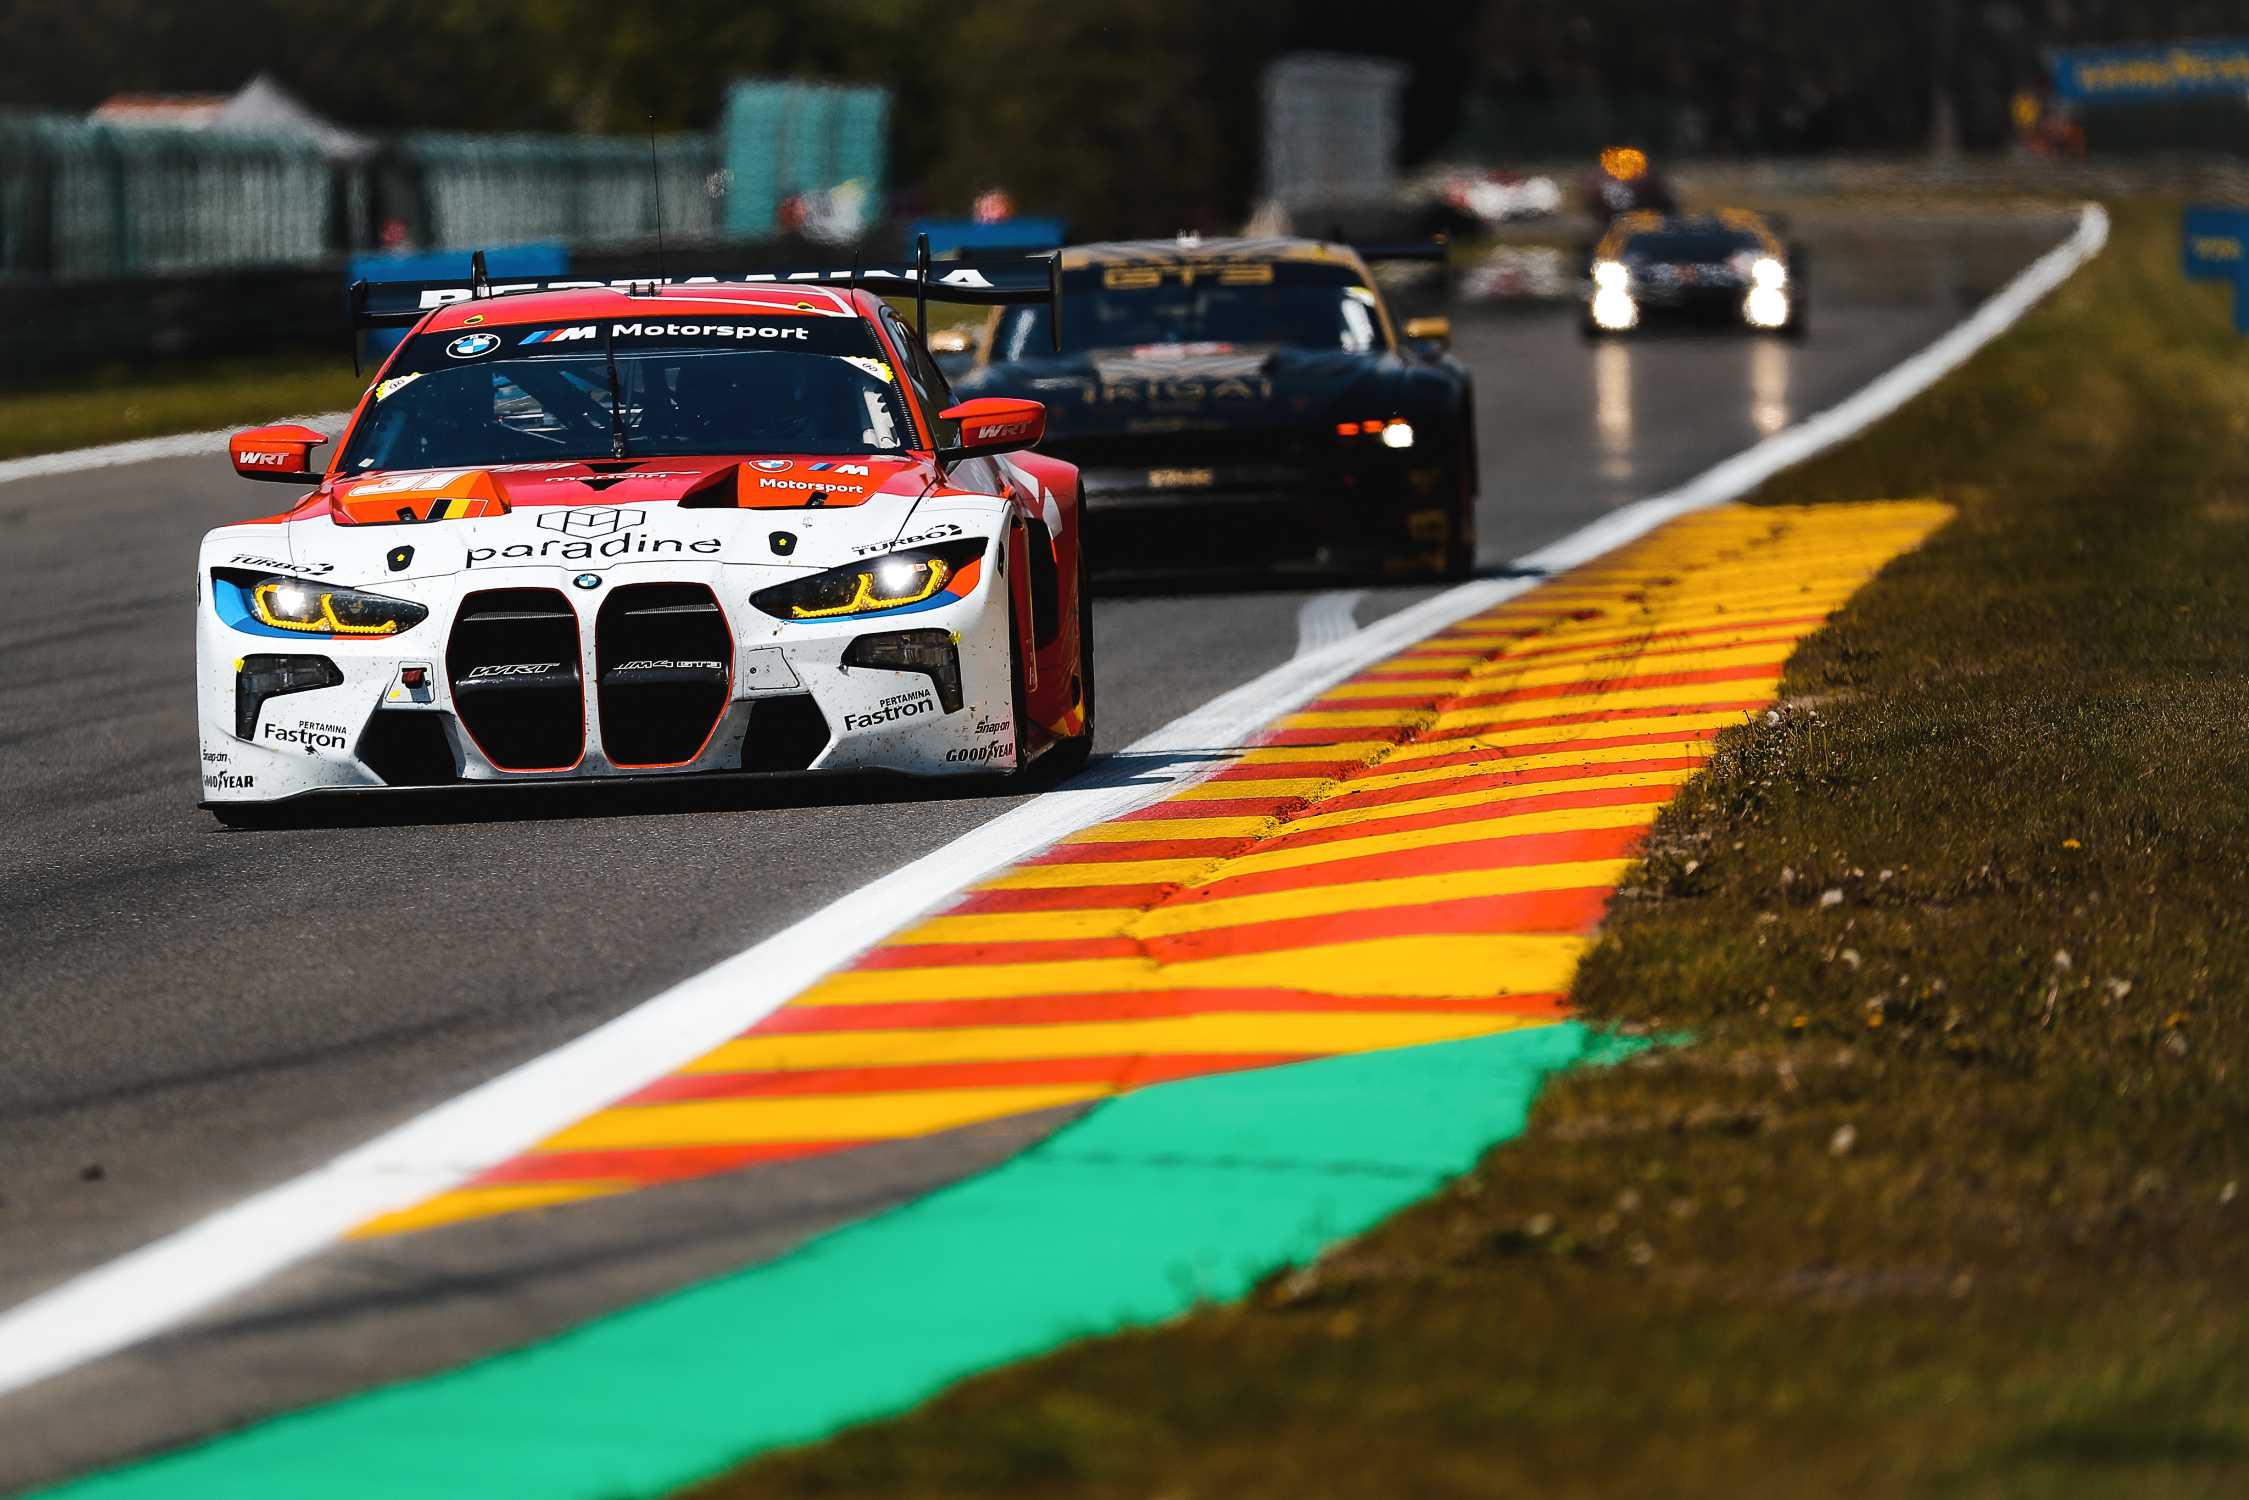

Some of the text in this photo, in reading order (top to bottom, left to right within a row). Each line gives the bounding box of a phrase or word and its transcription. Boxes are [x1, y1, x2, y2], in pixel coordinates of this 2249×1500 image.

[551, 323, 809, 342] M Motorsport
[978, 421, 1032, 439] WRT
[239, 451, 289, 465] WRT
[759, 478, 864, 494] Motorsport
[465, 532, 722, 569] paradine
[853, 531, 947, 555] TURBO
[230, 556, 312, 573] TURBO
[469, 662, 561, 678] WRT
[676, 660, 722, 669] GT3
[879, 688, 931, 708] PERTAMINA
[843, 698, 935, 732] Fastron
[264, 722, 346, 749] Fastron
[299, 720, 347, 735] PERTAMINA
[202, 771, 254, 791] OODYEAR
